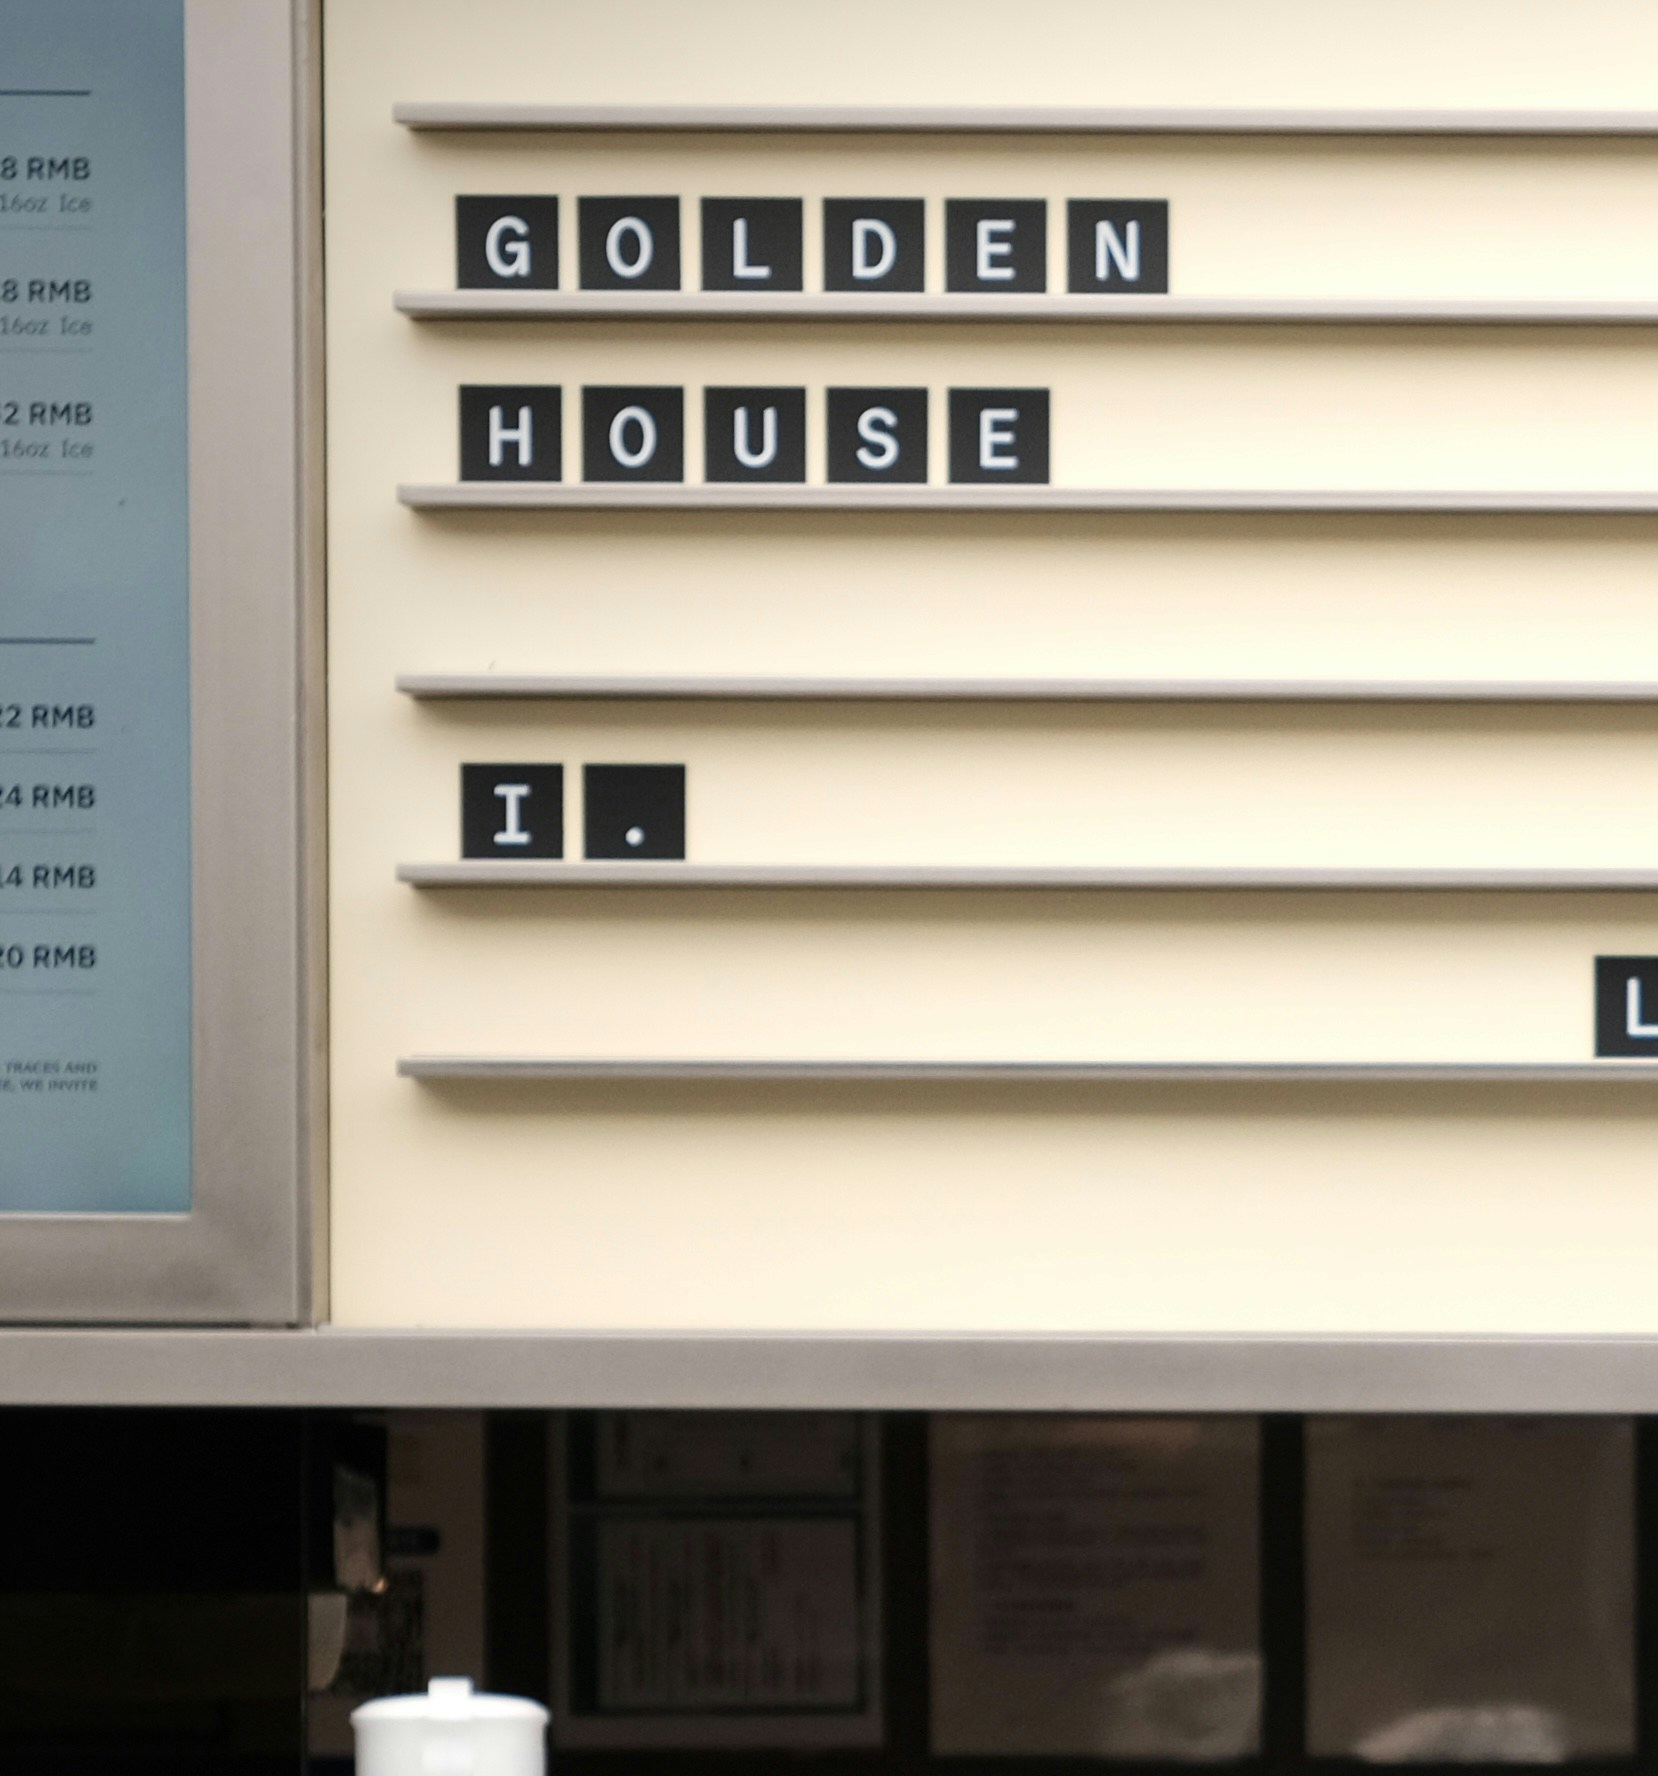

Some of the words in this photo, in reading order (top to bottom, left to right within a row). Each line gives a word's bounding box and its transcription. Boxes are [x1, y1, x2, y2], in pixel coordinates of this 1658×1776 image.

[27, 156, 91, 181] RMB
[484, 215, 1141, 283] GOLDEN
[28, 279, 92, 303] RMB
[0, 401, 20, 426] 2
[29, 401, 93, 426] RMB
[488, 405, 1020, 471] HOUSE
[0, 703, 22, 729] 2
[31, 703, 95, 729] RMB
[0, 783, 22, 809] 4
[32, 784, 96, 809] RMB
[0, 863, 22, 889] 4
[32, 864, 96, 889] RMB
[0, 943, 24, 970] 0
[33, 944, 97, 969] RMB
